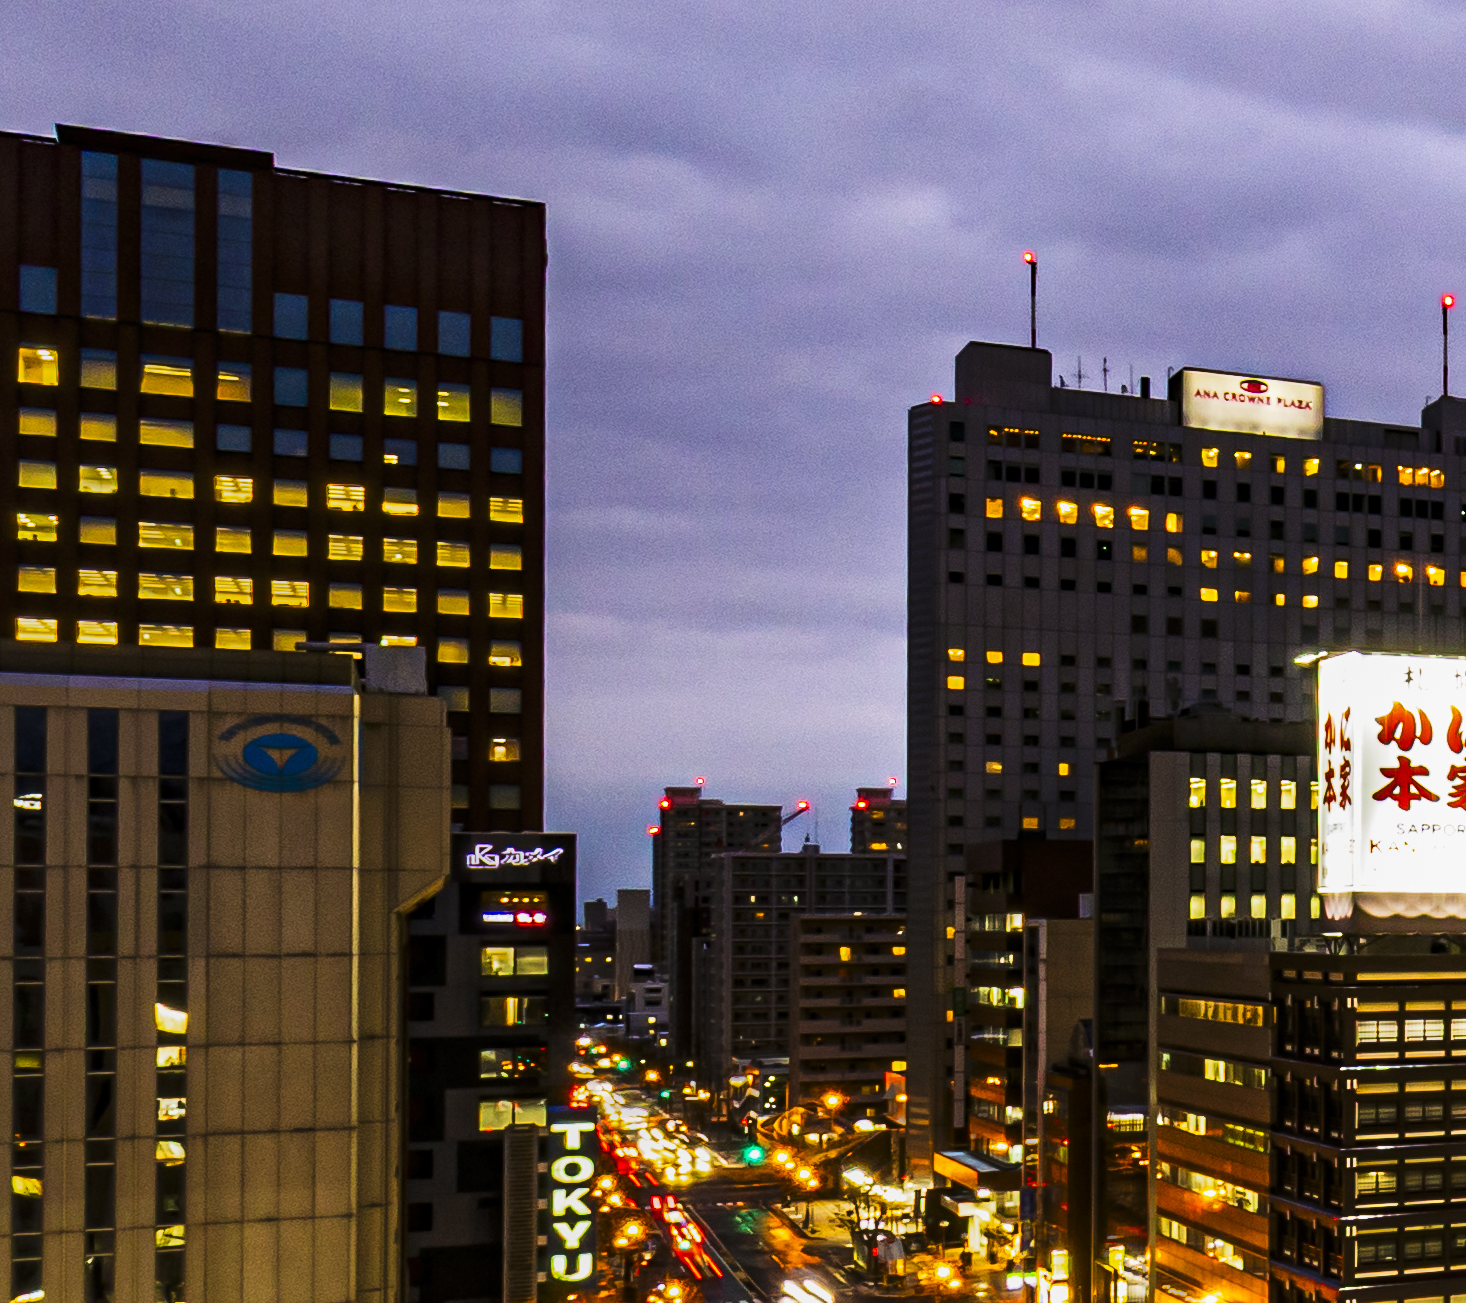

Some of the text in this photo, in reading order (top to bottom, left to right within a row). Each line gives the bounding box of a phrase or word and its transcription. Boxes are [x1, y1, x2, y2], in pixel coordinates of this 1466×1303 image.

[1194, 389, 1312, 410] ANA CROWNE PLAZA
[550, 1121, 596, 1283] TOKYU
